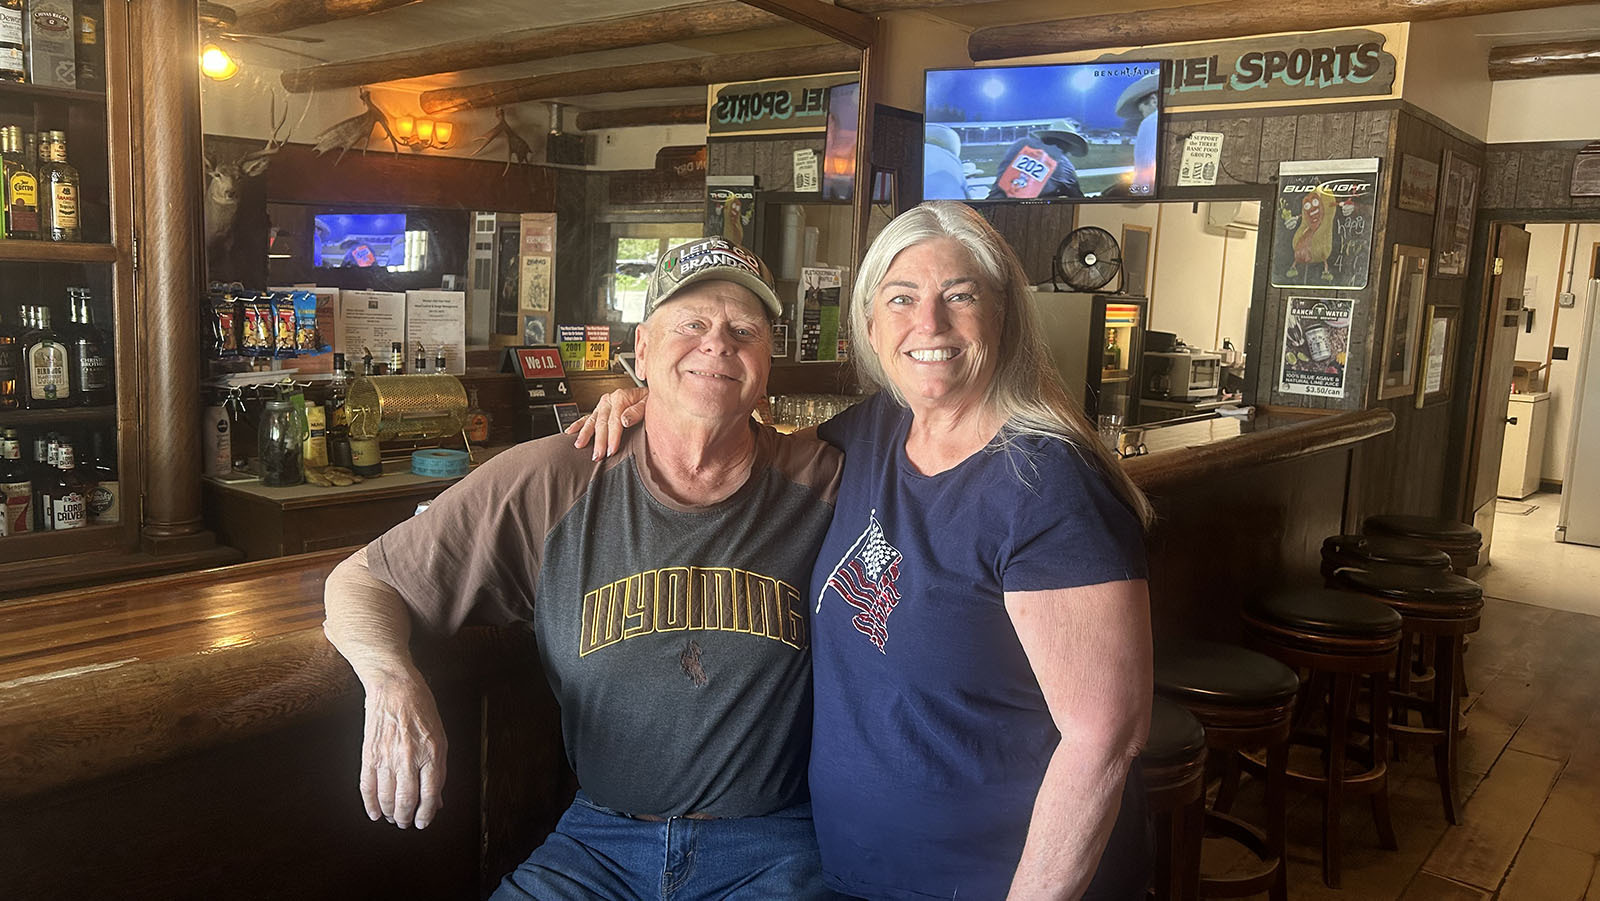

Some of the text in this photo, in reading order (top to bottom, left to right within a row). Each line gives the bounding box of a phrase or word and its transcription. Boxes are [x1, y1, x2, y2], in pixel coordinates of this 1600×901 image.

[1231, 43, 1381, 91] SPORTS
[1016, 156, 1045, 179] 202
[1283, 183, 1371, 193] BUD LIGHT
[733, 246, 760, 268] GO
[1292, 308, 1348, 318] RANCH WATER
[566, 343, 581, 352] 2001
[590, 343, 605, 352] 2001
[525, 355, 557, 369] We I.D.
[558, 381, 567, 394] 4
[1306, 386, 1341, 395] $3.50/can
[63, 503, 83, 512] LORD
[579, 565, 806, 658] WYOMING
